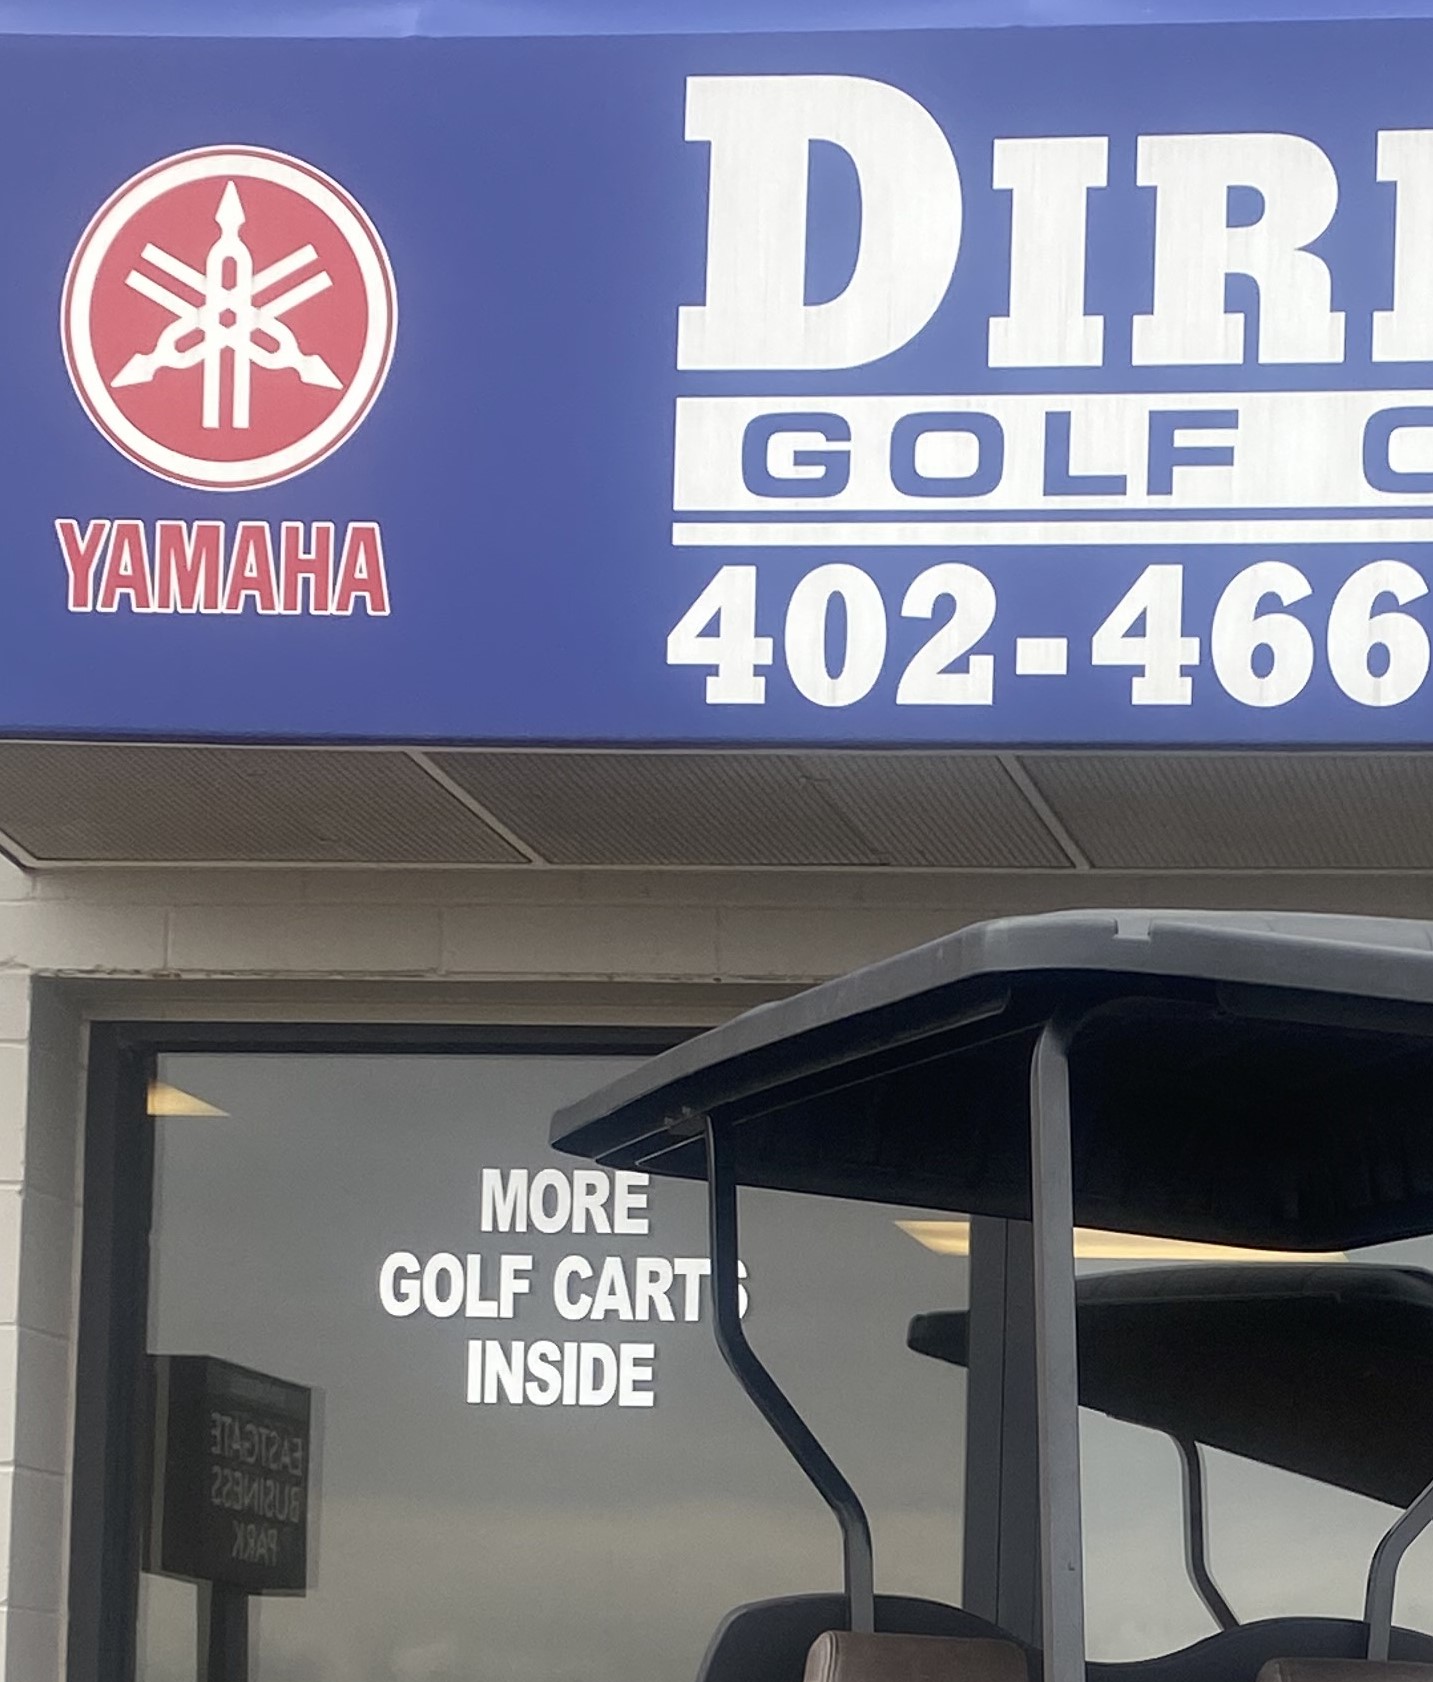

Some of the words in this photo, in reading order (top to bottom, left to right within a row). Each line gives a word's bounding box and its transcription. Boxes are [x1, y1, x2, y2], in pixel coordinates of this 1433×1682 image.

[741, 409, 1239, 498] GOLF
[55, 519, 391, 616] YAMAHA
[480, 1168, 650, 1235] MORE
[379, 1251, 534, 1319] GOLF
[553, 1255, 749, 1322] CART
[466, 1339, 656, 1408] INSIDE
